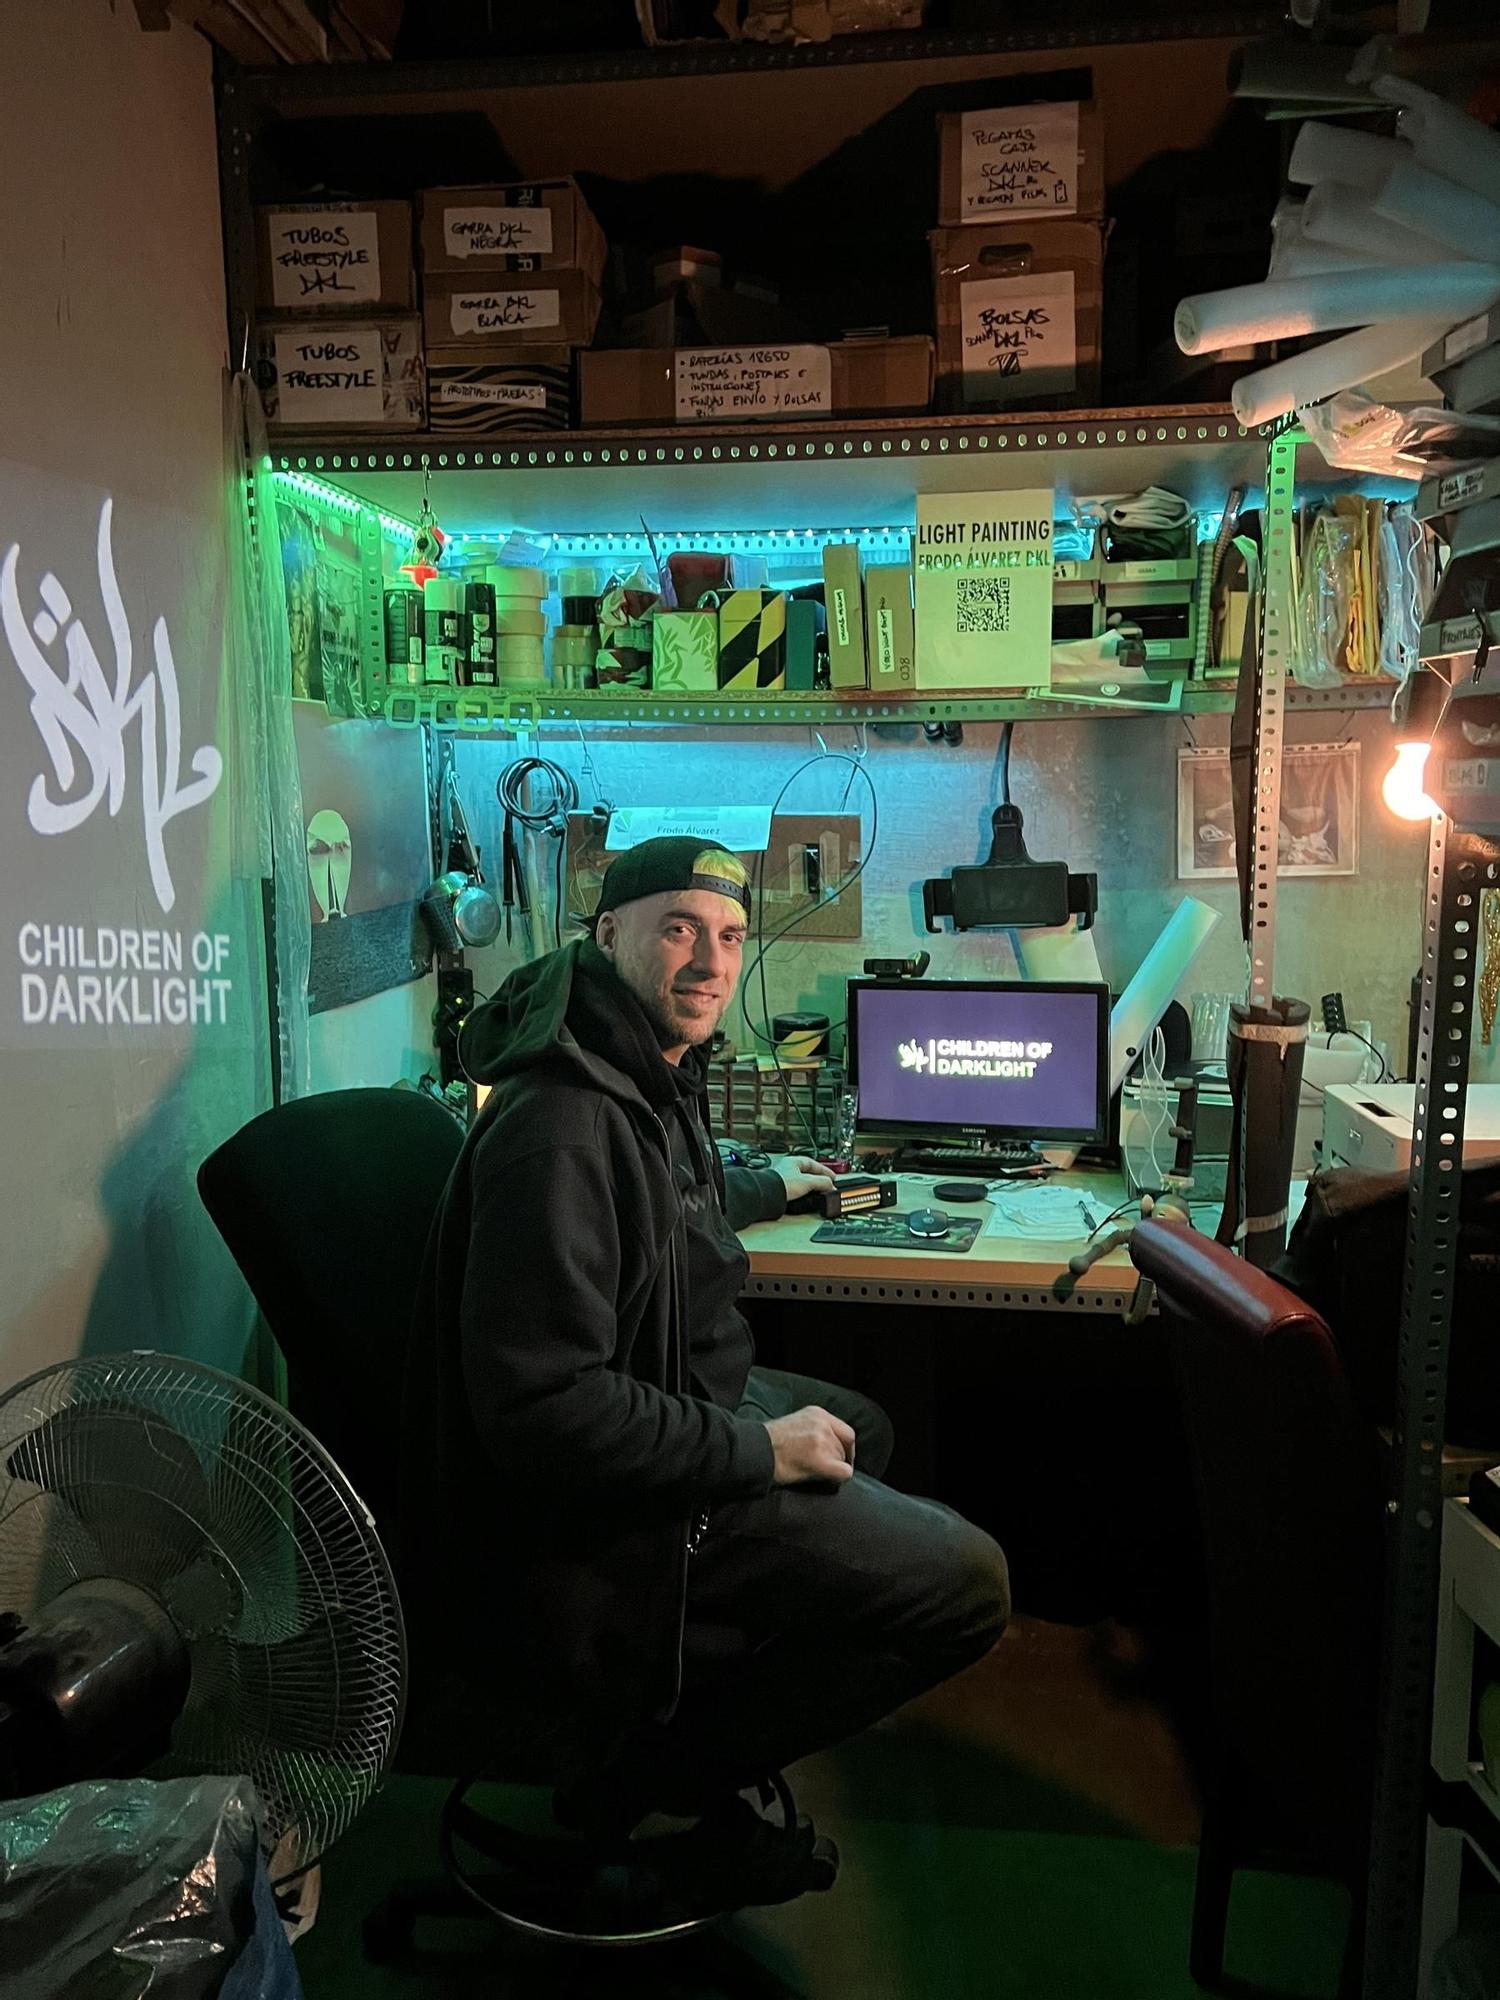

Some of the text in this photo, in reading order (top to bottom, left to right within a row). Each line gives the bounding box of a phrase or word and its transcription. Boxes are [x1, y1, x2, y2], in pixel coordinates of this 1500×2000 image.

[981, 157, 1056, 177] SCANNER
[281, 226, 350, 246] TUBOS
[451, 221, 494, 235] GARRA
[470, 236, 523, 249] NEGRA
[276, 249, 370, 270] FREESTYLE
[477, 309, 532, 328] BLANCA
[978, 307, 1051, 326] BOLSAS
[296, 342, 361, 361] TUBOS
[748, 350, 790, 363] 18650
[282, 369, 377, 389] FREESTYLE
[919, 520, 1051, 545] LIGHT PAINTING
[919, 553, 962, 570] FRODO
[1026, 549, 1051, 567] DKL
[657, 823, 721, 835] Frodo Álvarez
[18, 921, 231, 973] CHILDREN OF
[20, 973, 232, 1025] DARKLIGHT
[936, 1039, 1024, 1058] CHILDREN
[1026, 1041, 1053, 1060] OF
[936, 1058, 1038, 1078] DARKLIGHT
